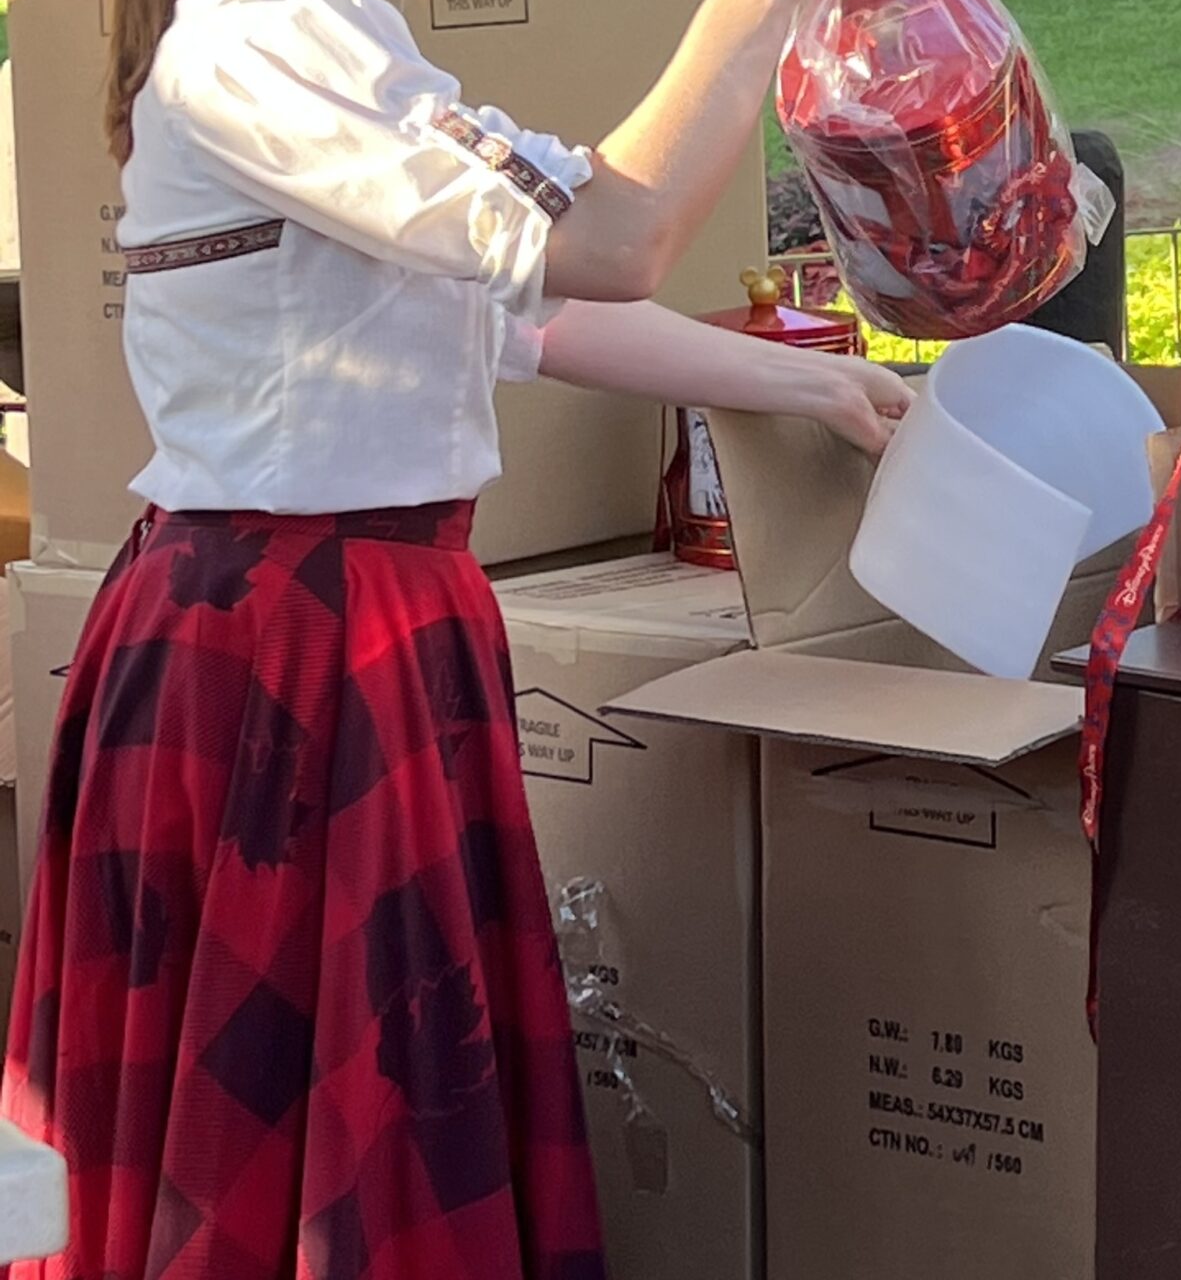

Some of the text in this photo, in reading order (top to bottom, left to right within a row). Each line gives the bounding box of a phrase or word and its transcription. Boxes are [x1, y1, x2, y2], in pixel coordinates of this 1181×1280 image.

[527, 743, 555, 761] WAY
[557, 748, 576, 763] UP
[988, 1038, 1024, 1064] KGS
[988, 1076, 1024, 1101] KGS
[869, 1127, 901, 1151] CTN
[1018, 1119, 1044, 1143] CM
